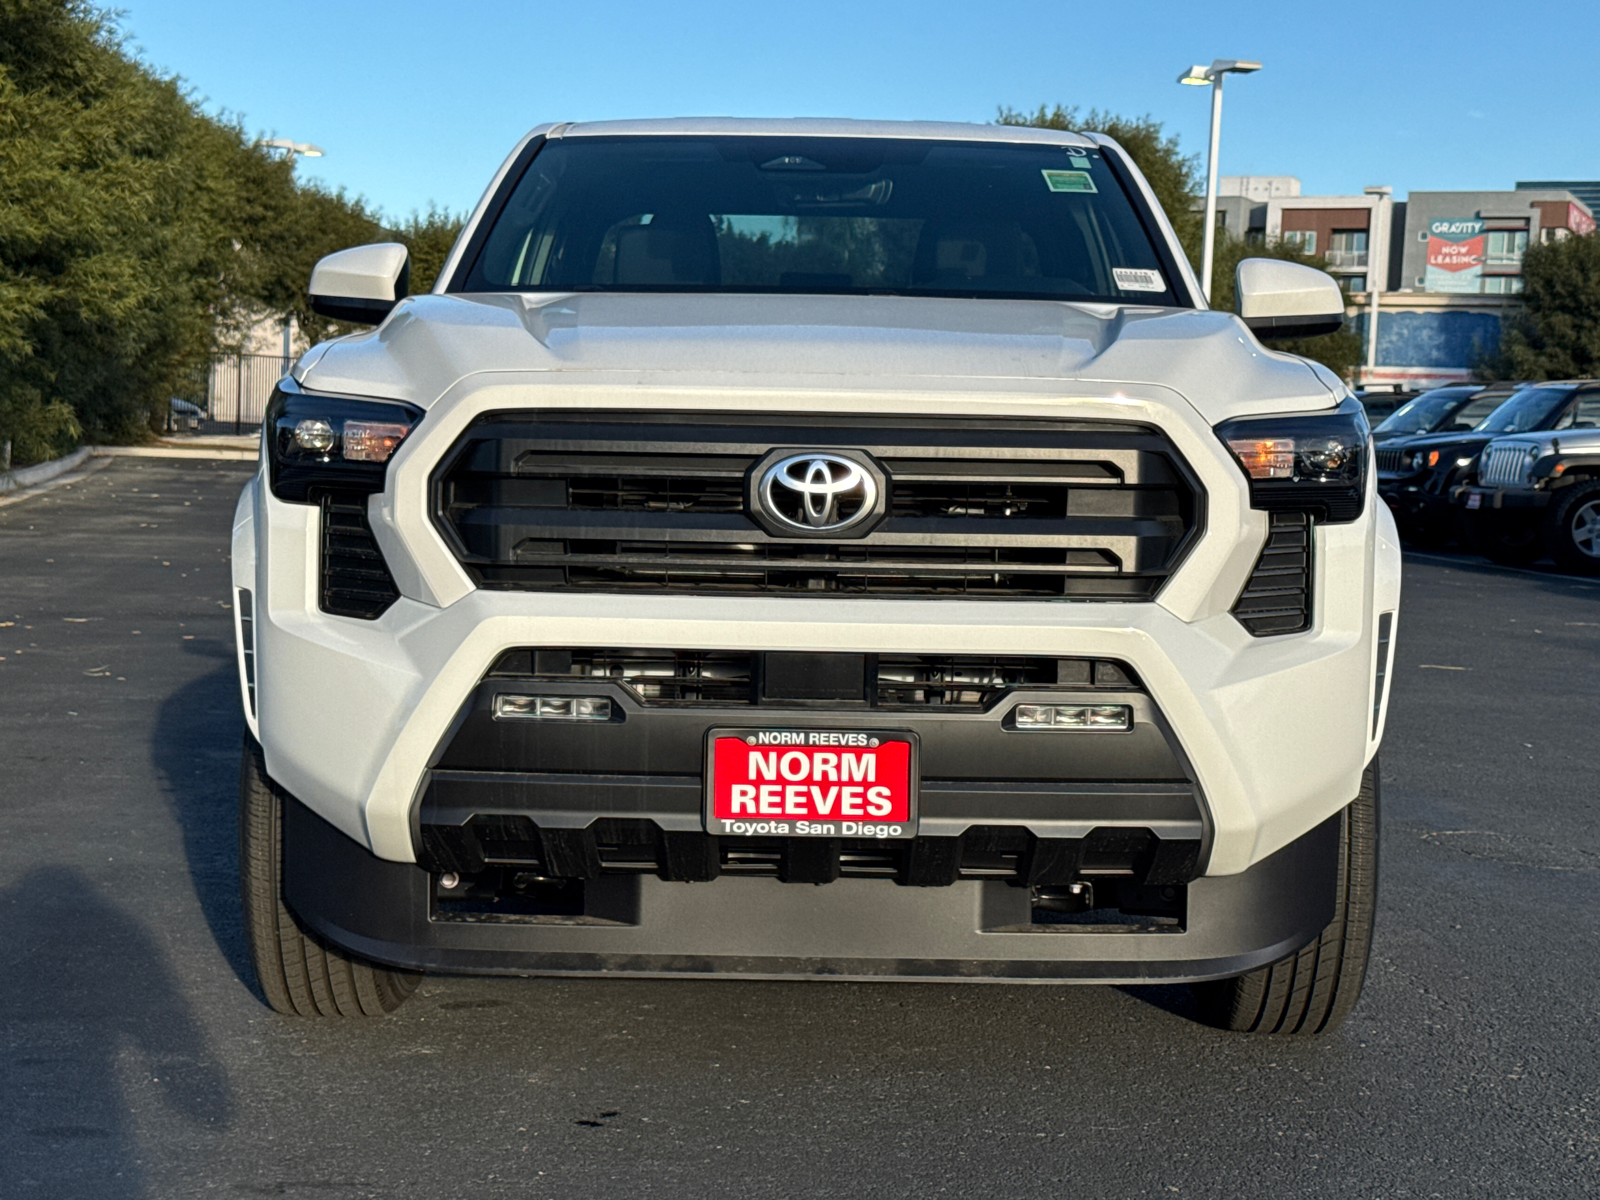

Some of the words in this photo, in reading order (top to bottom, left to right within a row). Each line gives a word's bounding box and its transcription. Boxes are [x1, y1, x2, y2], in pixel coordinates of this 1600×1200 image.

[1431, 222, 1482, 233] GRAVITY
[1441, 245, 1469, 254] NOW
[758, 732, 804, 745] NORM
[809, 732, 868, 746] REEVES
[748, 751, 876, 782] NORM
[731, 784, 892, 816] REEVES
[721, 819, 789, 836] Toyota
[795, 821, 835, 835] San
[841, 822, 902, 838] Diego
